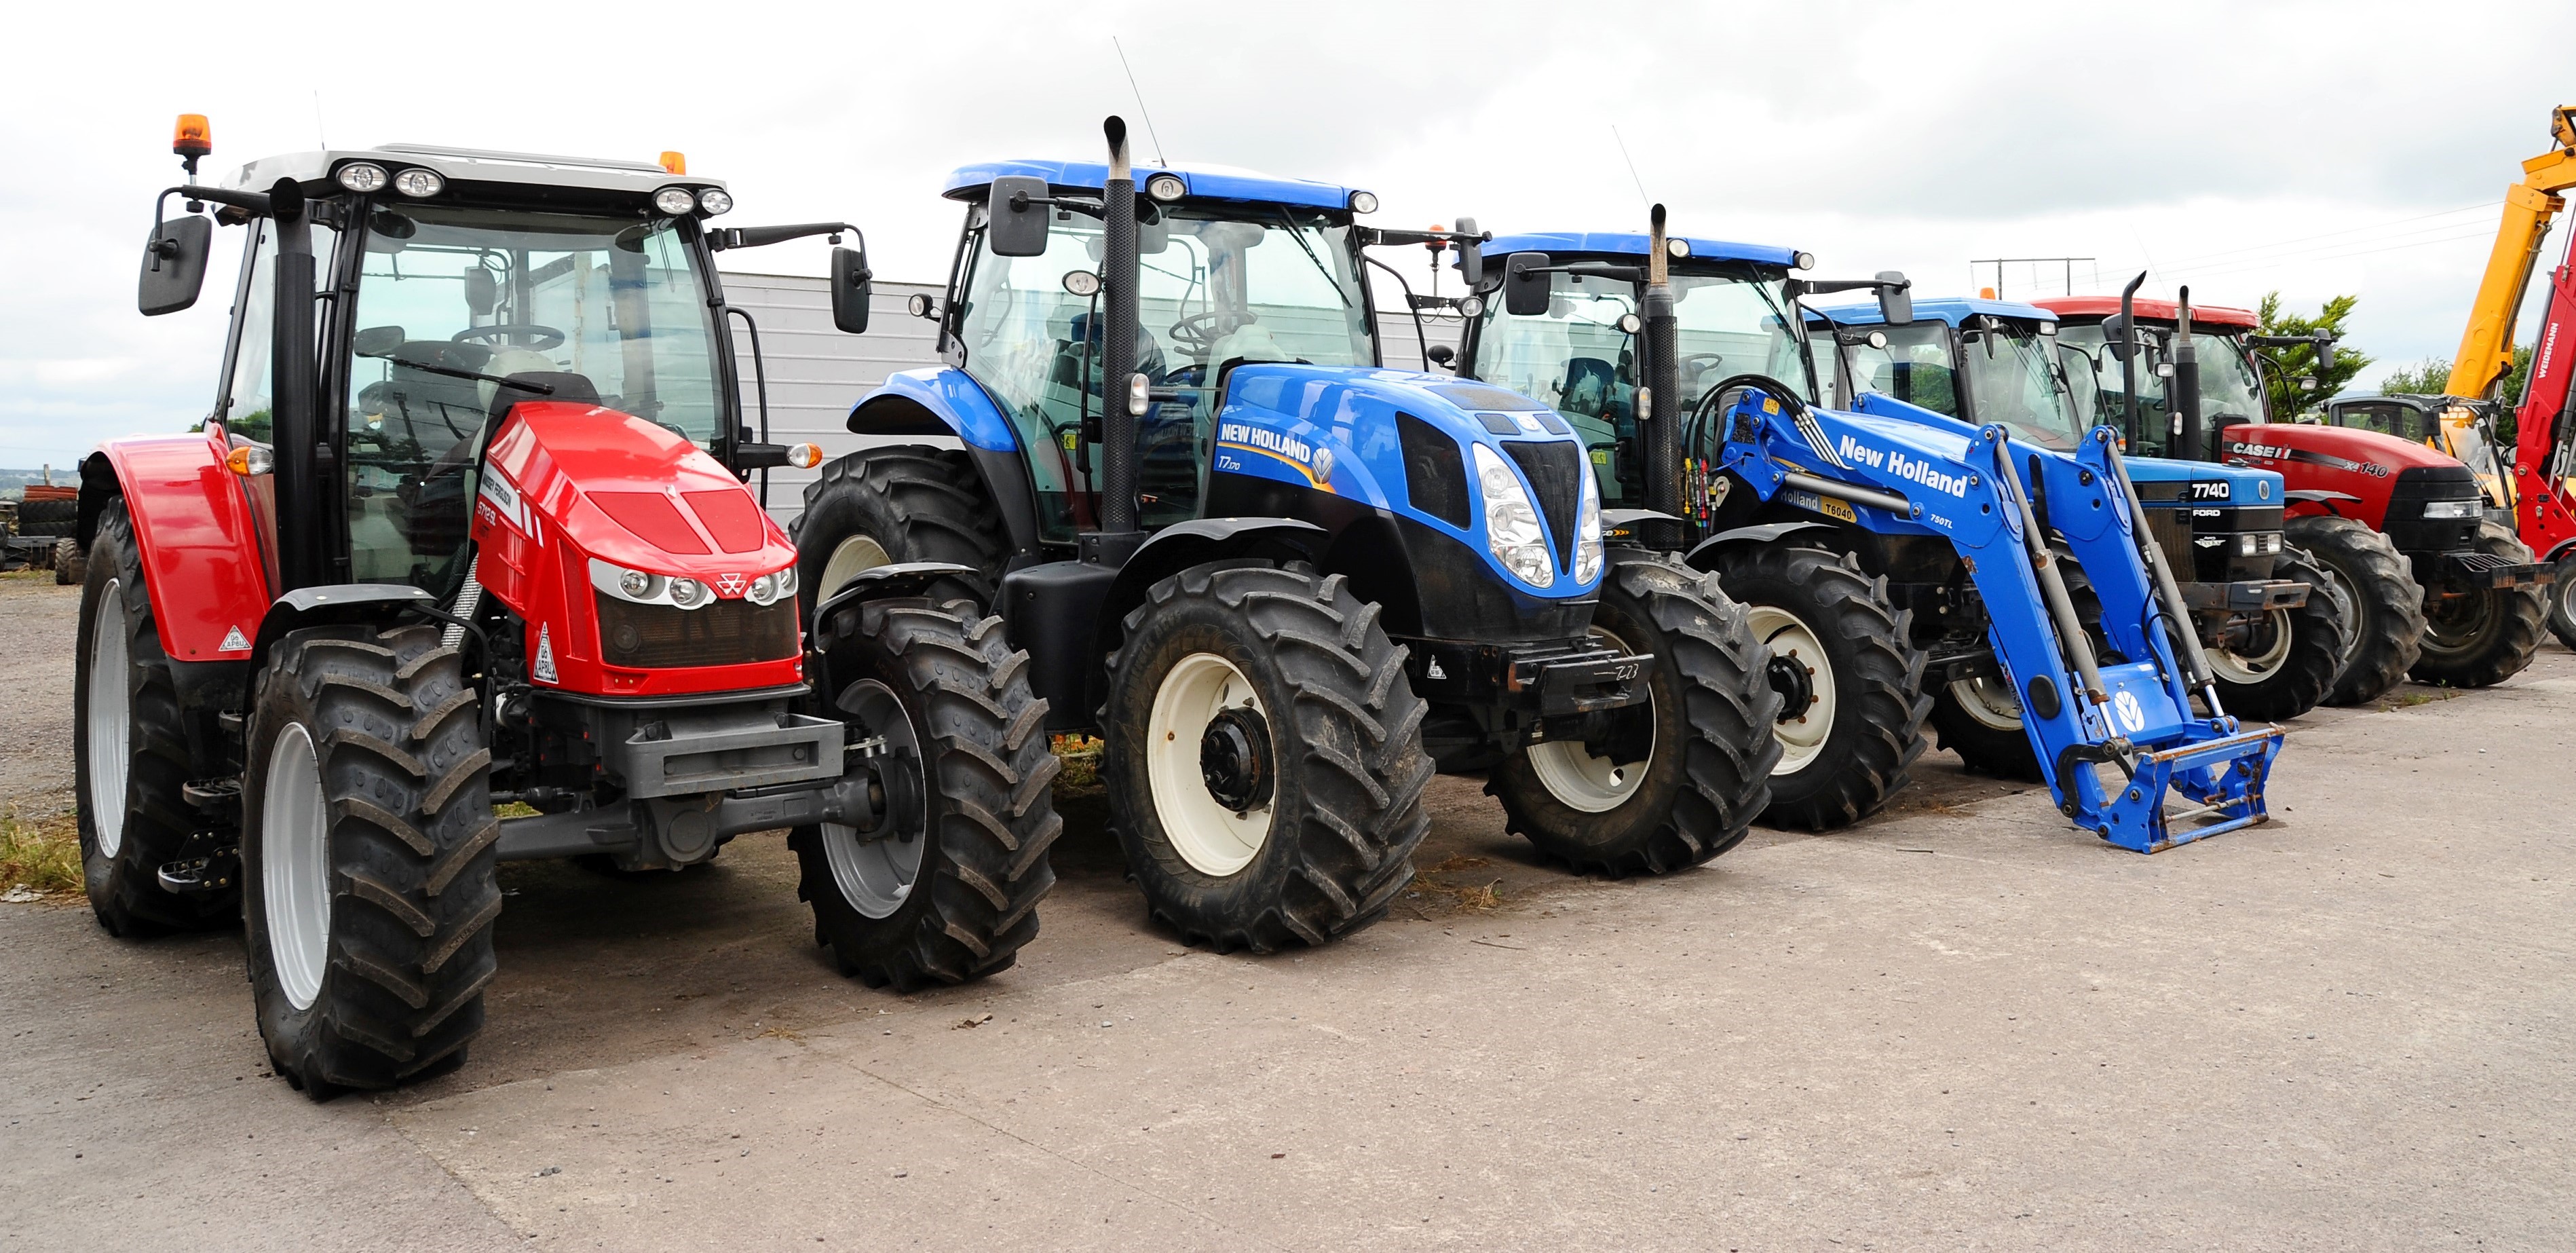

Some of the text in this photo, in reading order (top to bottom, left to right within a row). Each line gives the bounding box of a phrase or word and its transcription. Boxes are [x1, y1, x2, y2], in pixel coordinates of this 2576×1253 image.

[2538, 322, 2559, 379] WEIDEMANN
[1221, 424, 1310, 463] NEW HOLLAND
[2233, 443, 2275, 457] CASE
[1839, 434, 1968, 498] New Holland
[2360, 462, 2389, 479] 140
[494, 481, 512, 508] FERGUSON
[2192, 483, 2229, 498] 7740
[1781, 489, 1852, 520] Holland T6040
[1930, 513, 1953, 529] 750TL
